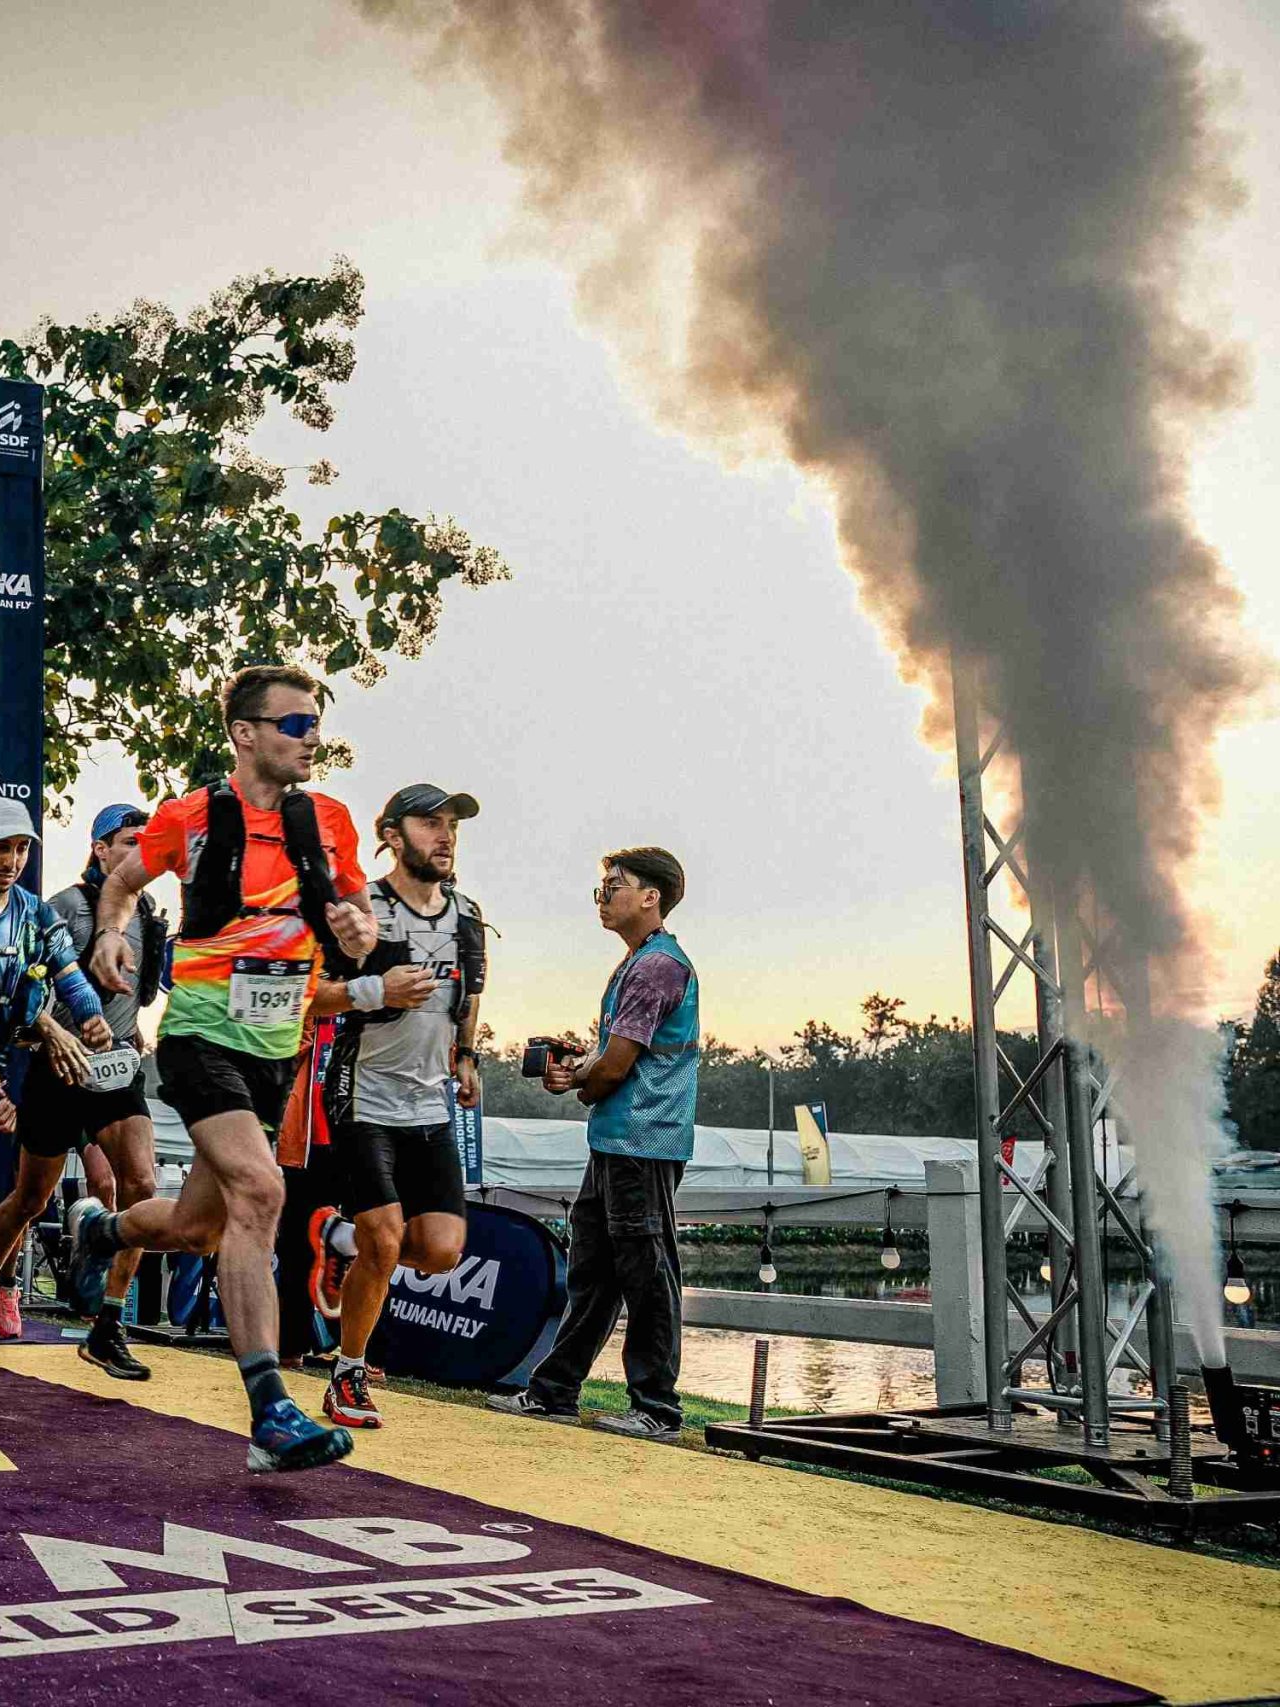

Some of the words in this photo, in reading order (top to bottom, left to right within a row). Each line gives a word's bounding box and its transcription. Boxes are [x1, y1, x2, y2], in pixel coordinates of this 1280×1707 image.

[15, 601, 32, 610] FLY
[250, 991, 291, 1008] 1939
[94, 1062, 128, 1079] 1013
[391, 1254, 500, 1311] OKA
[389, 1297, 453, 1332] HUMAN
[451, 1316, 485, 1338] FLY
[242, 1576, 644, 1625] SERIES
